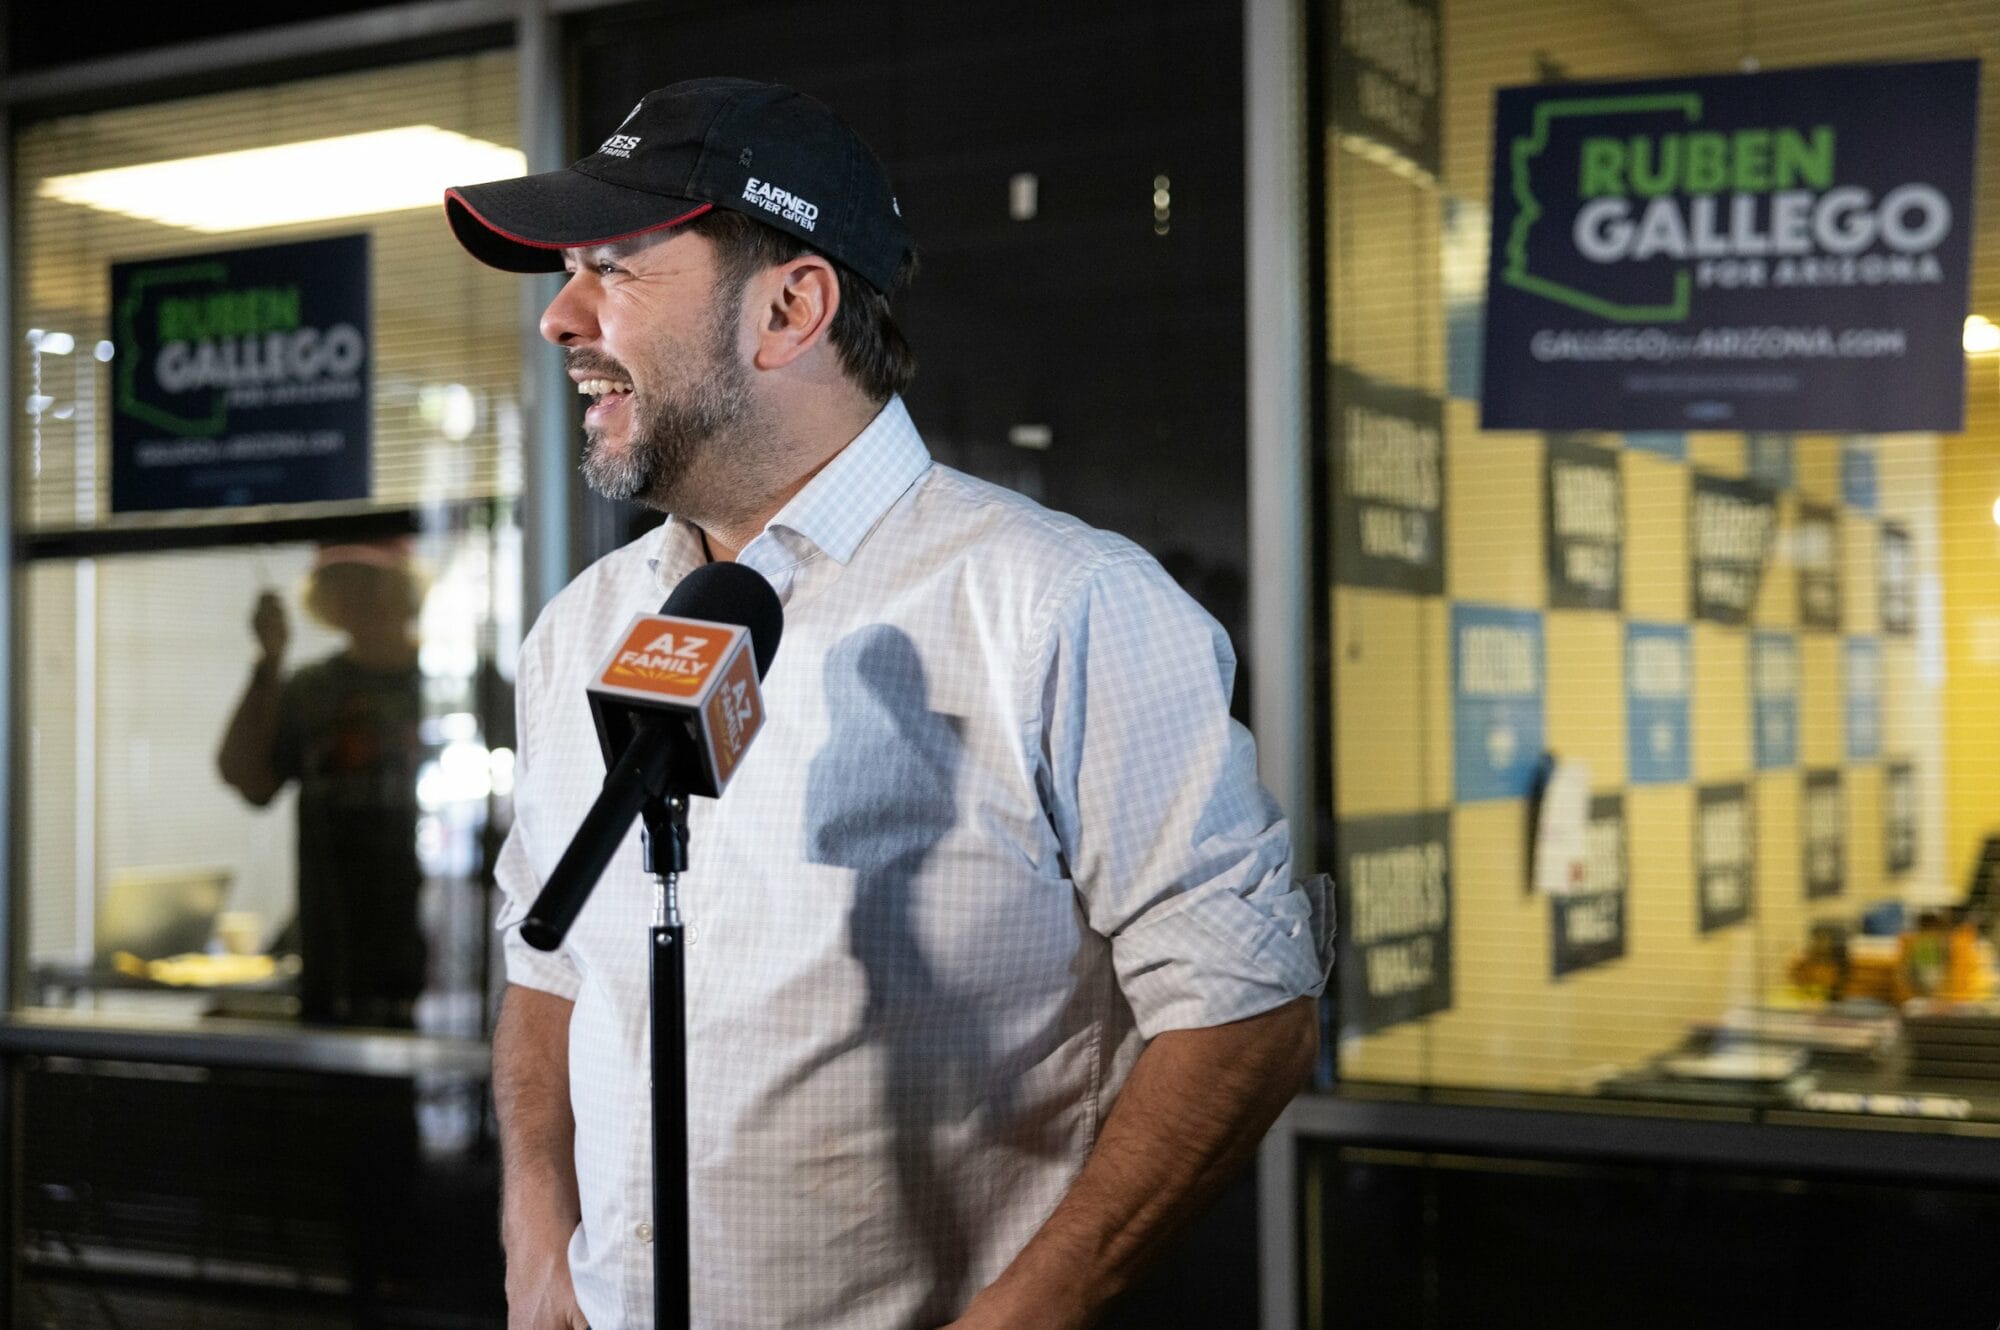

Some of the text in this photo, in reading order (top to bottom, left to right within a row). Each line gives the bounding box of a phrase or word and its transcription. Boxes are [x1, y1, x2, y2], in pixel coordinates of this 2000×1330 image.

[1580, 126, 1835, 197] RUBEN
[742, 190, 816, 232] NEVER GIVEN
[745, 177, 818, 221] EARNED
[1573, 183, 1953, 263] GALLEGO
[1697, 254, 1942, 288] FOR ARIZONA
[155, 322, 363, 393] GALLEGO
[618, 651, 708, 676] FAMILY
[645, 632, 708, 660] AZ
[732, 679, 752, 732] AZ
